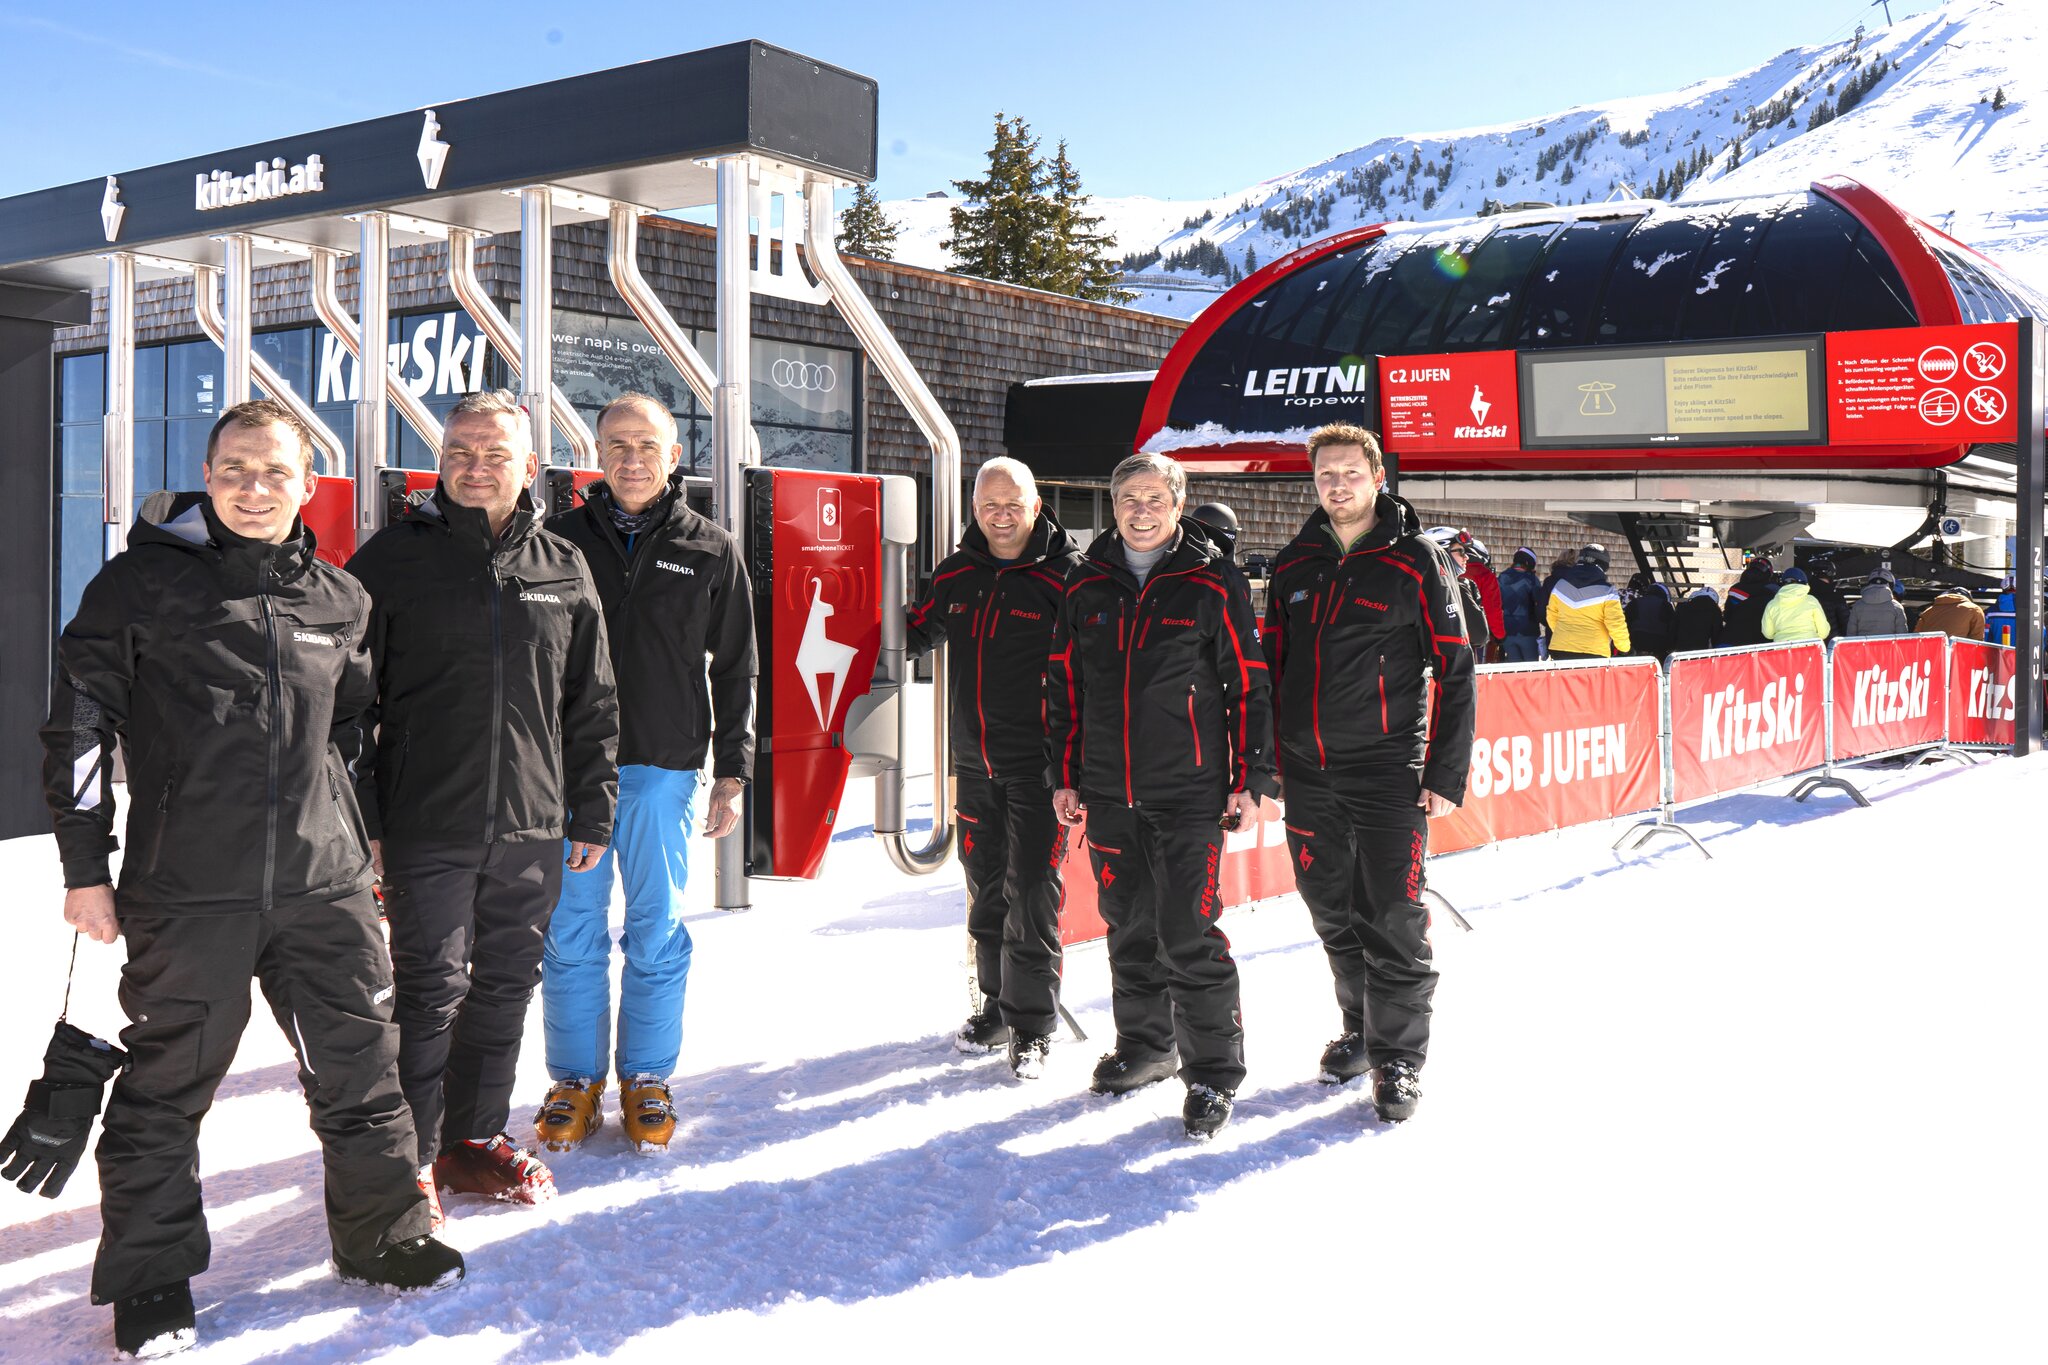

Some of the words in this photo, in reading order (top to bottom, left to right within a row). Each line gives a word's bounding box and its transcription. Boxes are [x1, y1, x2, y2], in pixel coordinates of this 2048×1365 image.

[195, 153, 323, 210] kitzski.at
[552, 333, 580, 345] wer
[585, 337, 612, 350] nap
[617, 338, 628, 351] is
[1244, 365, 1365, 396] LEITN
[1389, 369, 1407, 383] C2
[1410, 368, 1450, 383] JUFEN
[1739, 371, 1798, 380] Fahrgeschwindigkeit
[1454, 425, 1507, 438] KitzSki
[801, 544, 855, 552] smartphoneTICKET
[656, 560, 695, 576] SKIDATA
[519, 592, 561, 603] SKIDATA
[293, 631, 334, 646] SKIDATA
[1852, 659, 1931, 728] KitzSki
[1968, 666, 2016, 721] KitzS
[1700, 672, 1804, 762] KitzSki
[1471, 735, 1533, 798] 8SB
[1539, 723, 1626, 788] JUFEN
